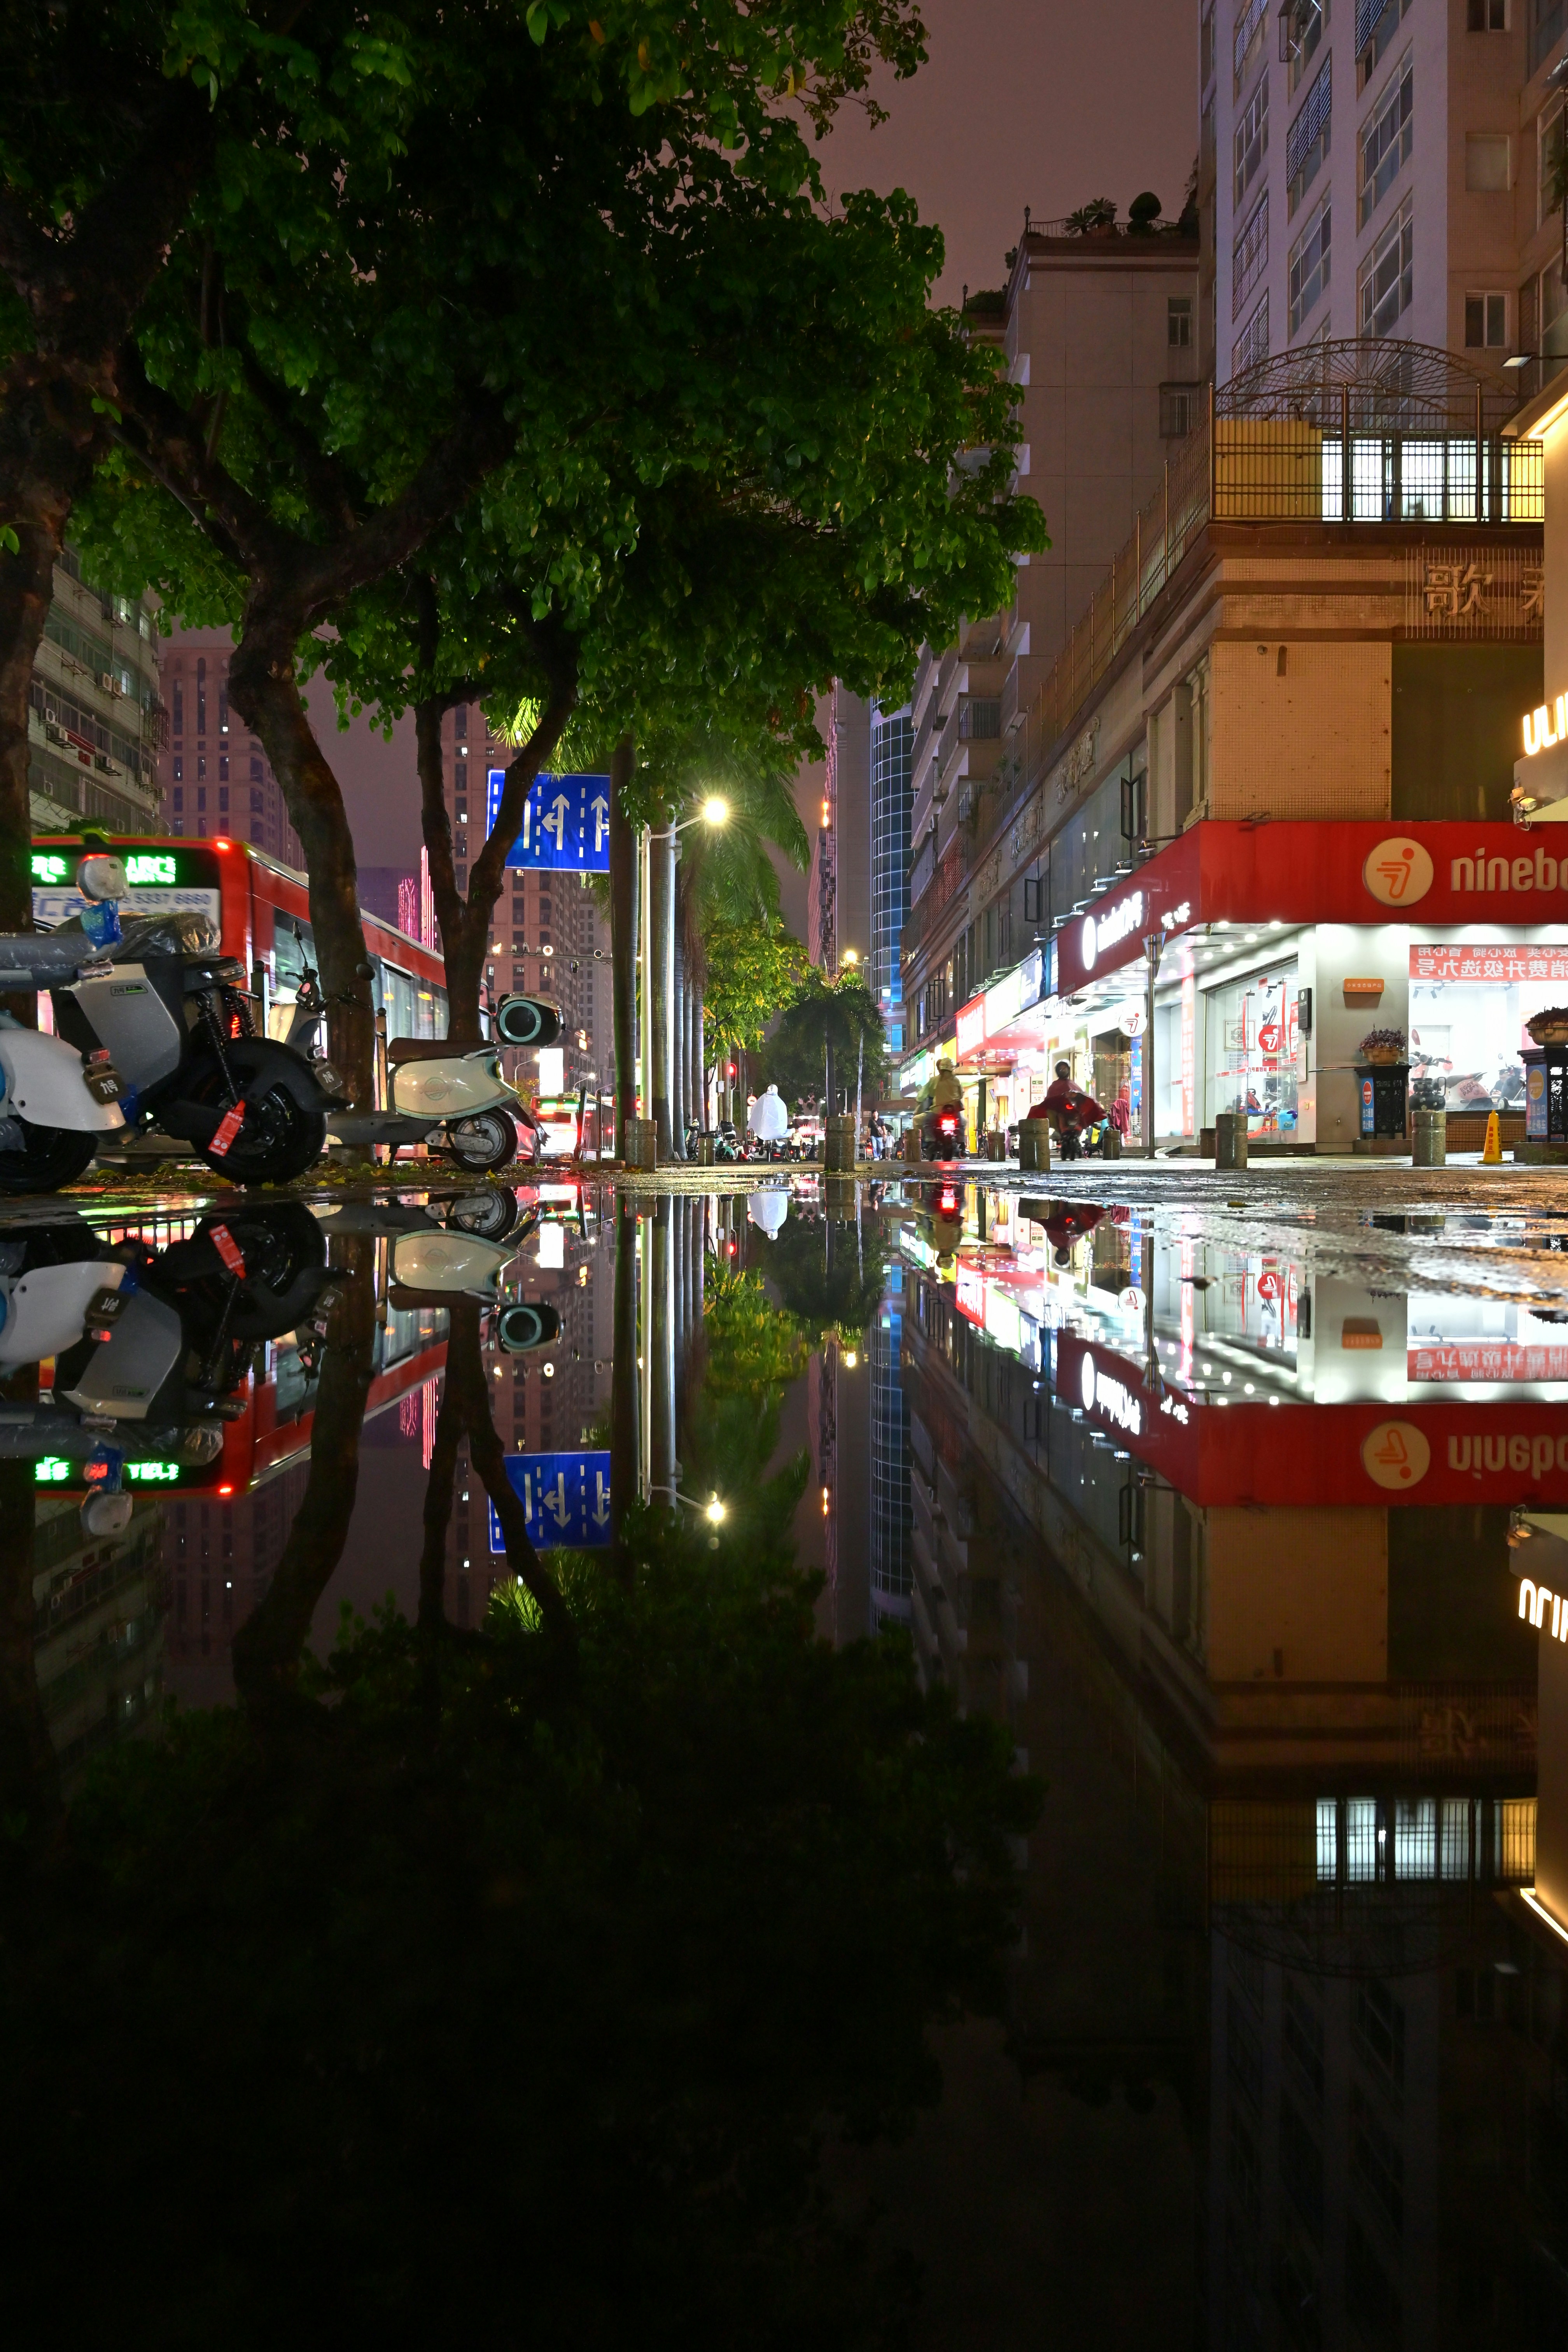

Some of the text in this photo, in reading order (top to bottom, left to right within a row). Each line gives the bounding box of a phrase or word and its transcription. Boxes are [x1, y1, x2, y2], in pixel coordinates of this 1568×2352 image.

[322, 1071, 334, 1084] 九号
[100, 1080, 118, 1094] 九号
[1460, 1081, 1474, 1092] EGGY
